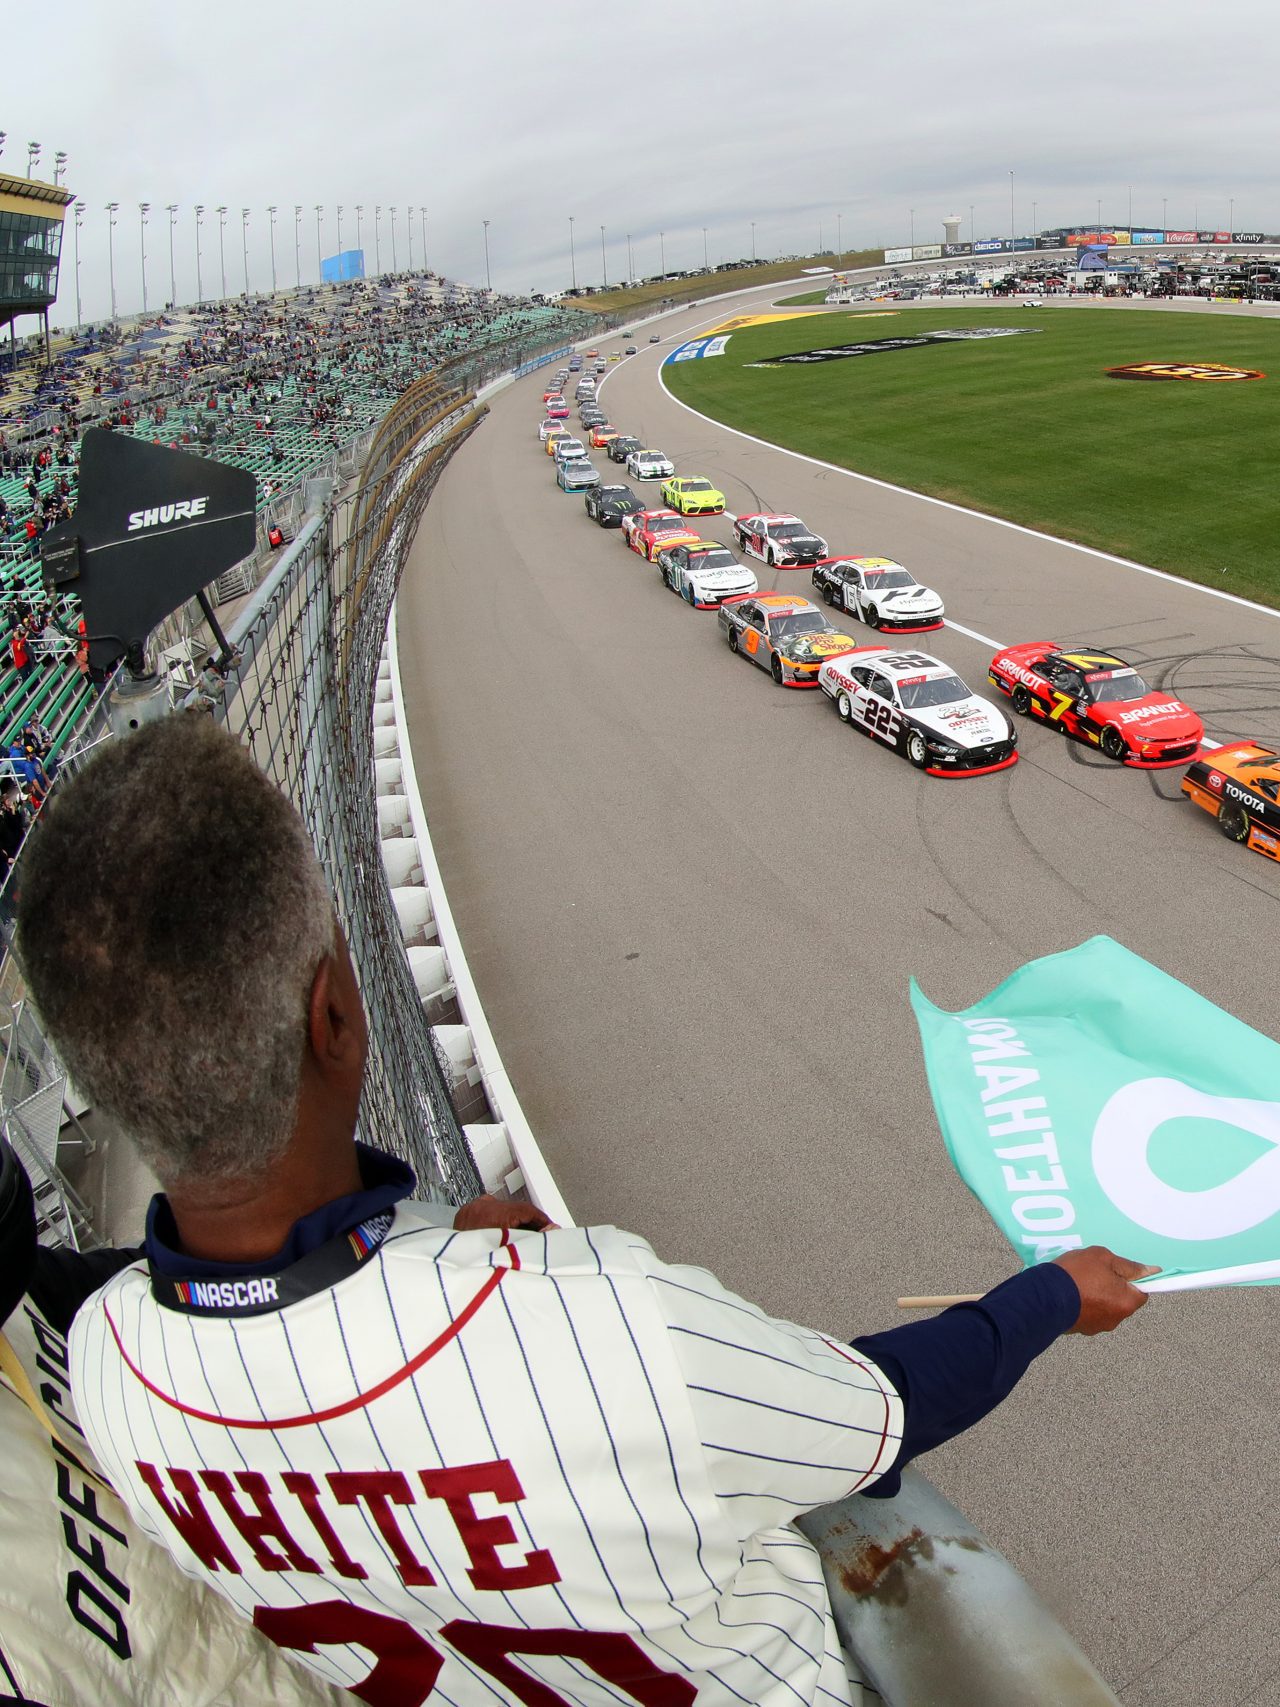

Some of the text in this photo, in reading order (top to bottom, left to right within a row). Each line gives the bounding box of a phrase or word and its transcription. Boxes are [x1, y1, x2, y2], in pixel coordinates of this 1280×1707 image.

[1235, 233, 1262, 243] xfinity
[127, 497, 207, 532] SHURE
[819, 643, 853, 652] Shops
[826, 666, 862, 695] ODYSSEY
[996, 658, 1048, 691] BRANDT
[863, 698, 892, 736] 22
[1050, 690, 1074, 721] 7
[1118, 701, 1184, 725] BRANDT
[948, 715, 988, 728] ODYSSEY
[1225, 783, 1266, 814] TOYOTA
[360, 1214, 392, 1246] NASC
[194, 1278, 279, 1308] NASCAR
[23, 1304, 133, 1661] OFFICIA
[134, 1458, 562, 1592] WHITE
